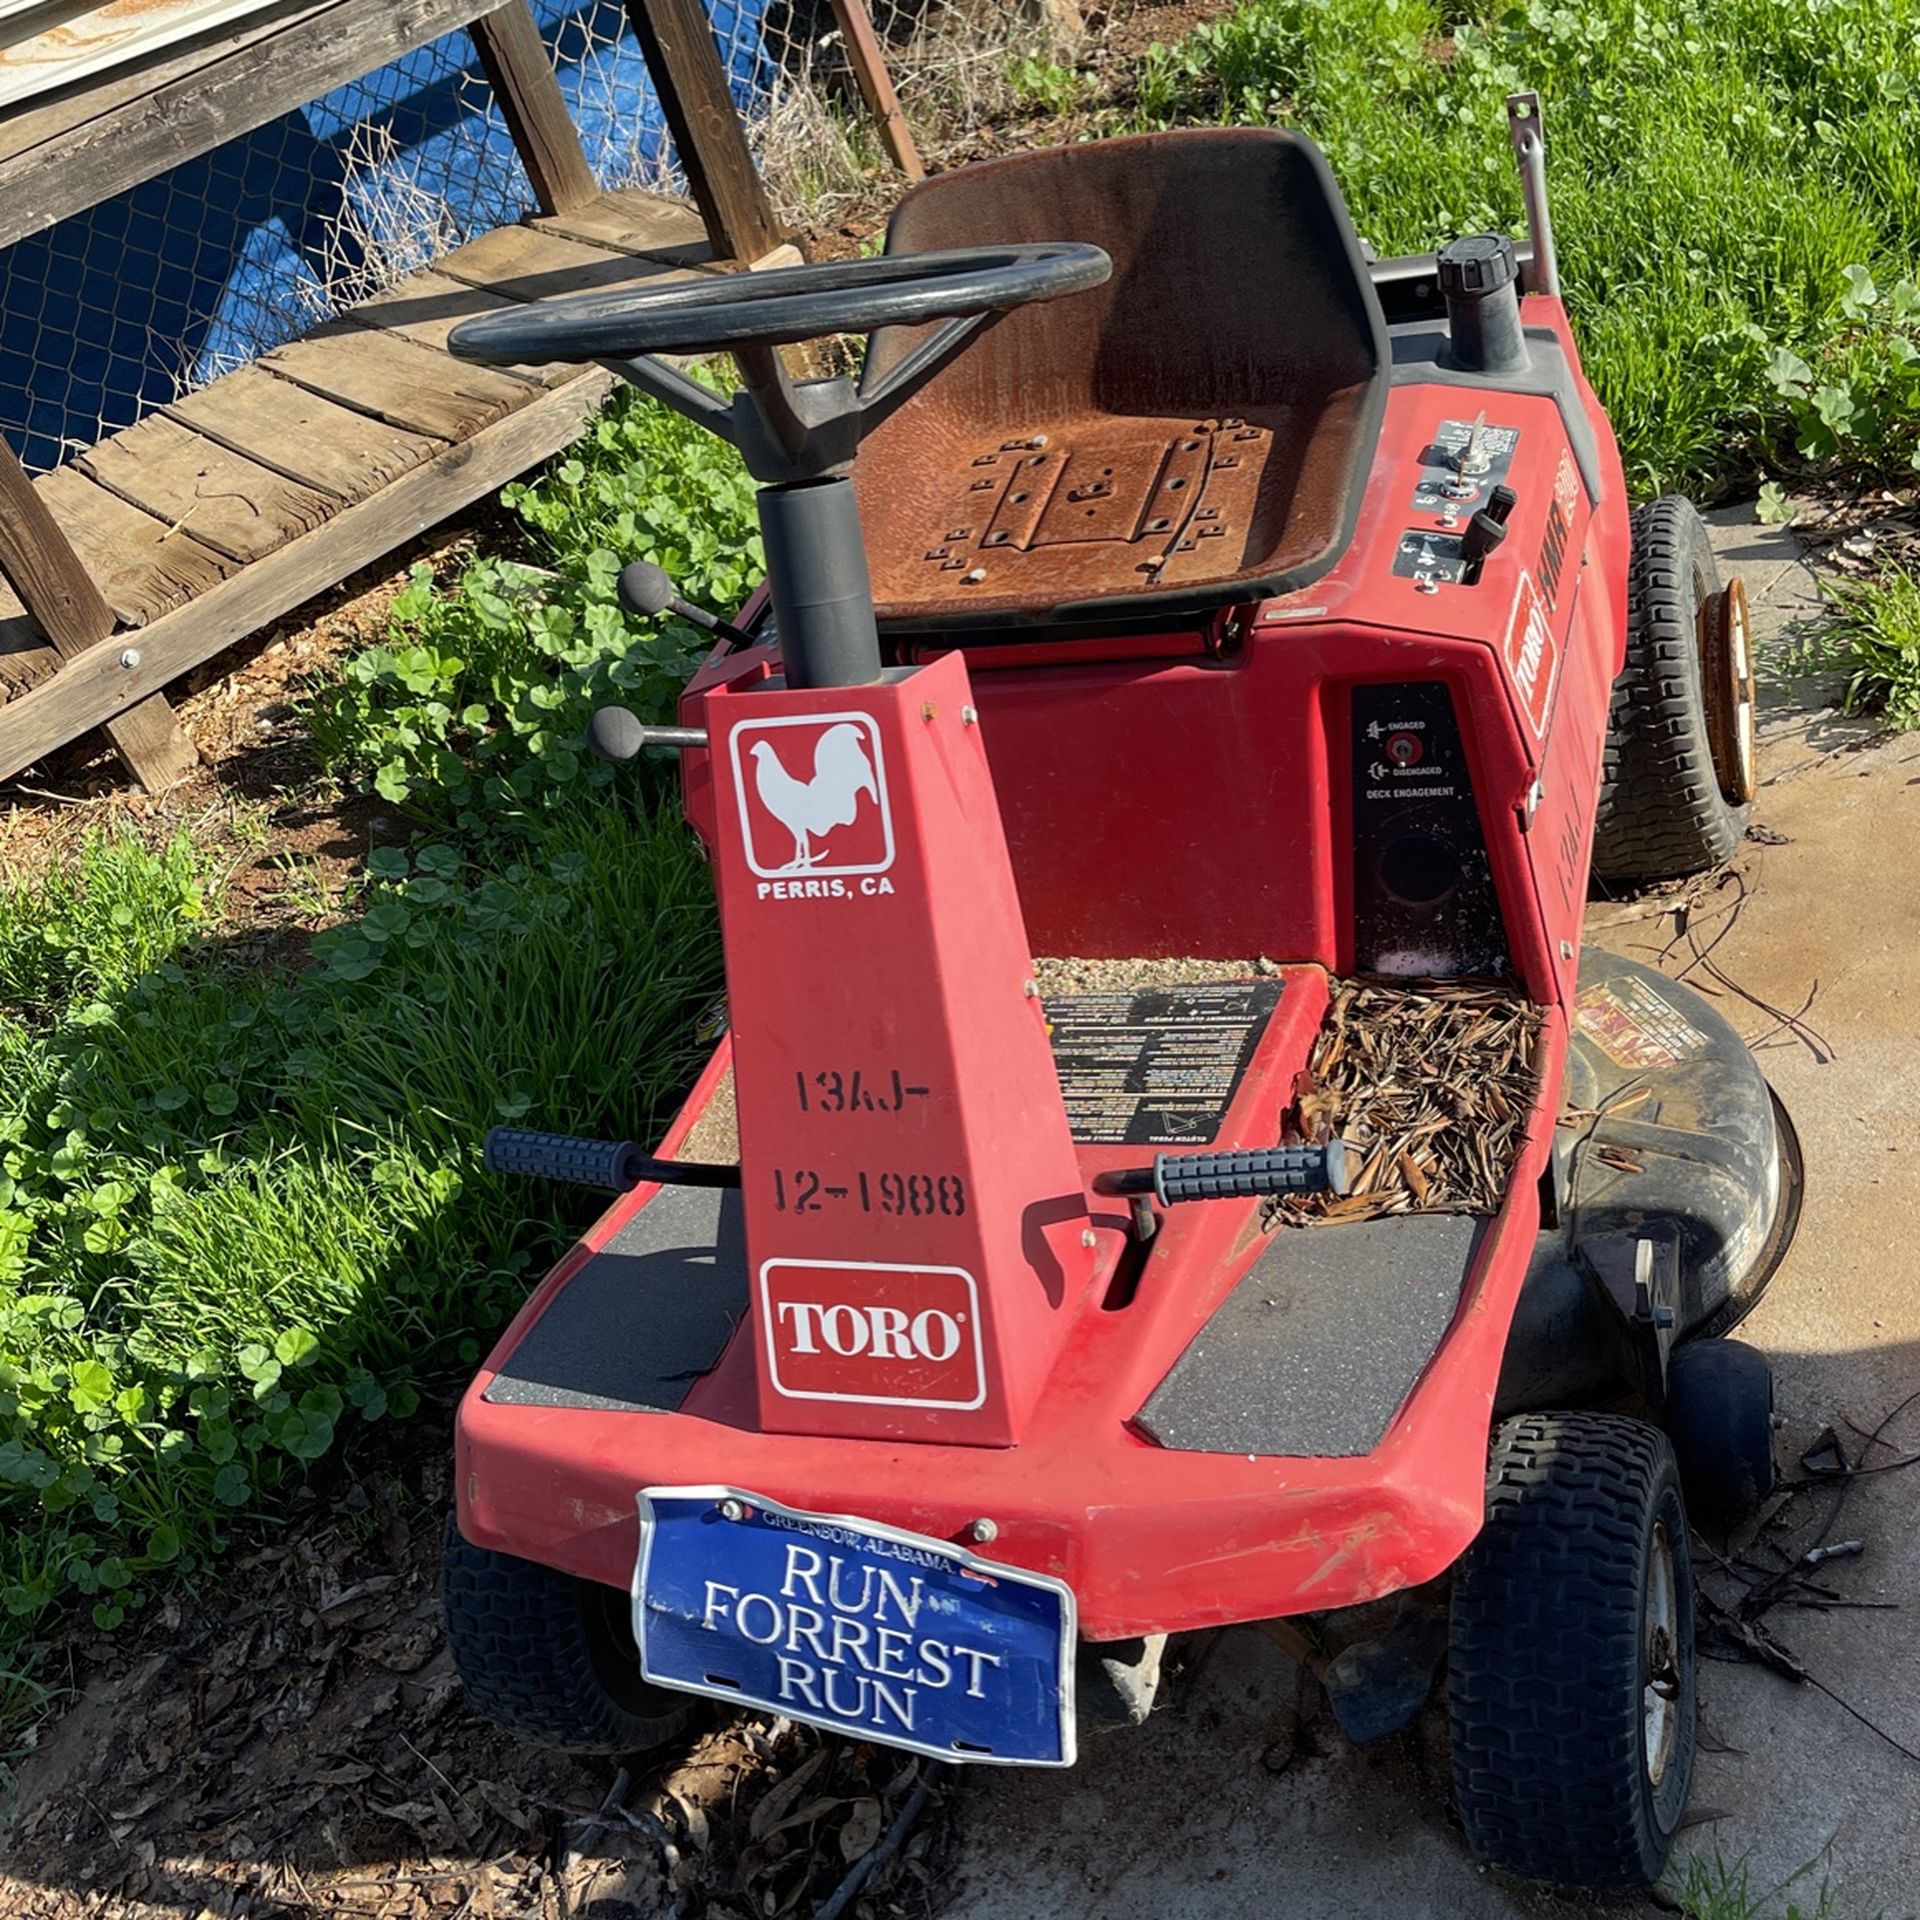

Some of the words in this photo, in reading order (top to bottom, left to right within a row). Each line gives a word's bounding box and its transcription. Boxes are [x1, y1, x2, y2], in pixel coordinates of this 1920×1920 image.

[1516, 606, 1545, 702] TORO
[1388, 721, 1425, 731] ENGAGED
[1366, 789, 1392, 799] DECK
[1393, 786, 1455, 799] ENGAGEMENT
[1392, 766, 1442, 777] DISENGAGED
[757, 879, 854, 900] PERRIS,
[860, 876, 895, 895] CA
[774, 1169, 965, 1217] 12-1988
[777, 1302, 961, 1361] TORO
[762, 1511, 861, 1552] GREENBOW,
[780, 1544, 923, 1629] RUN
[701, 1580, 1001, 1699] FORREST
[775, 1650, 918, 1732] RUN
